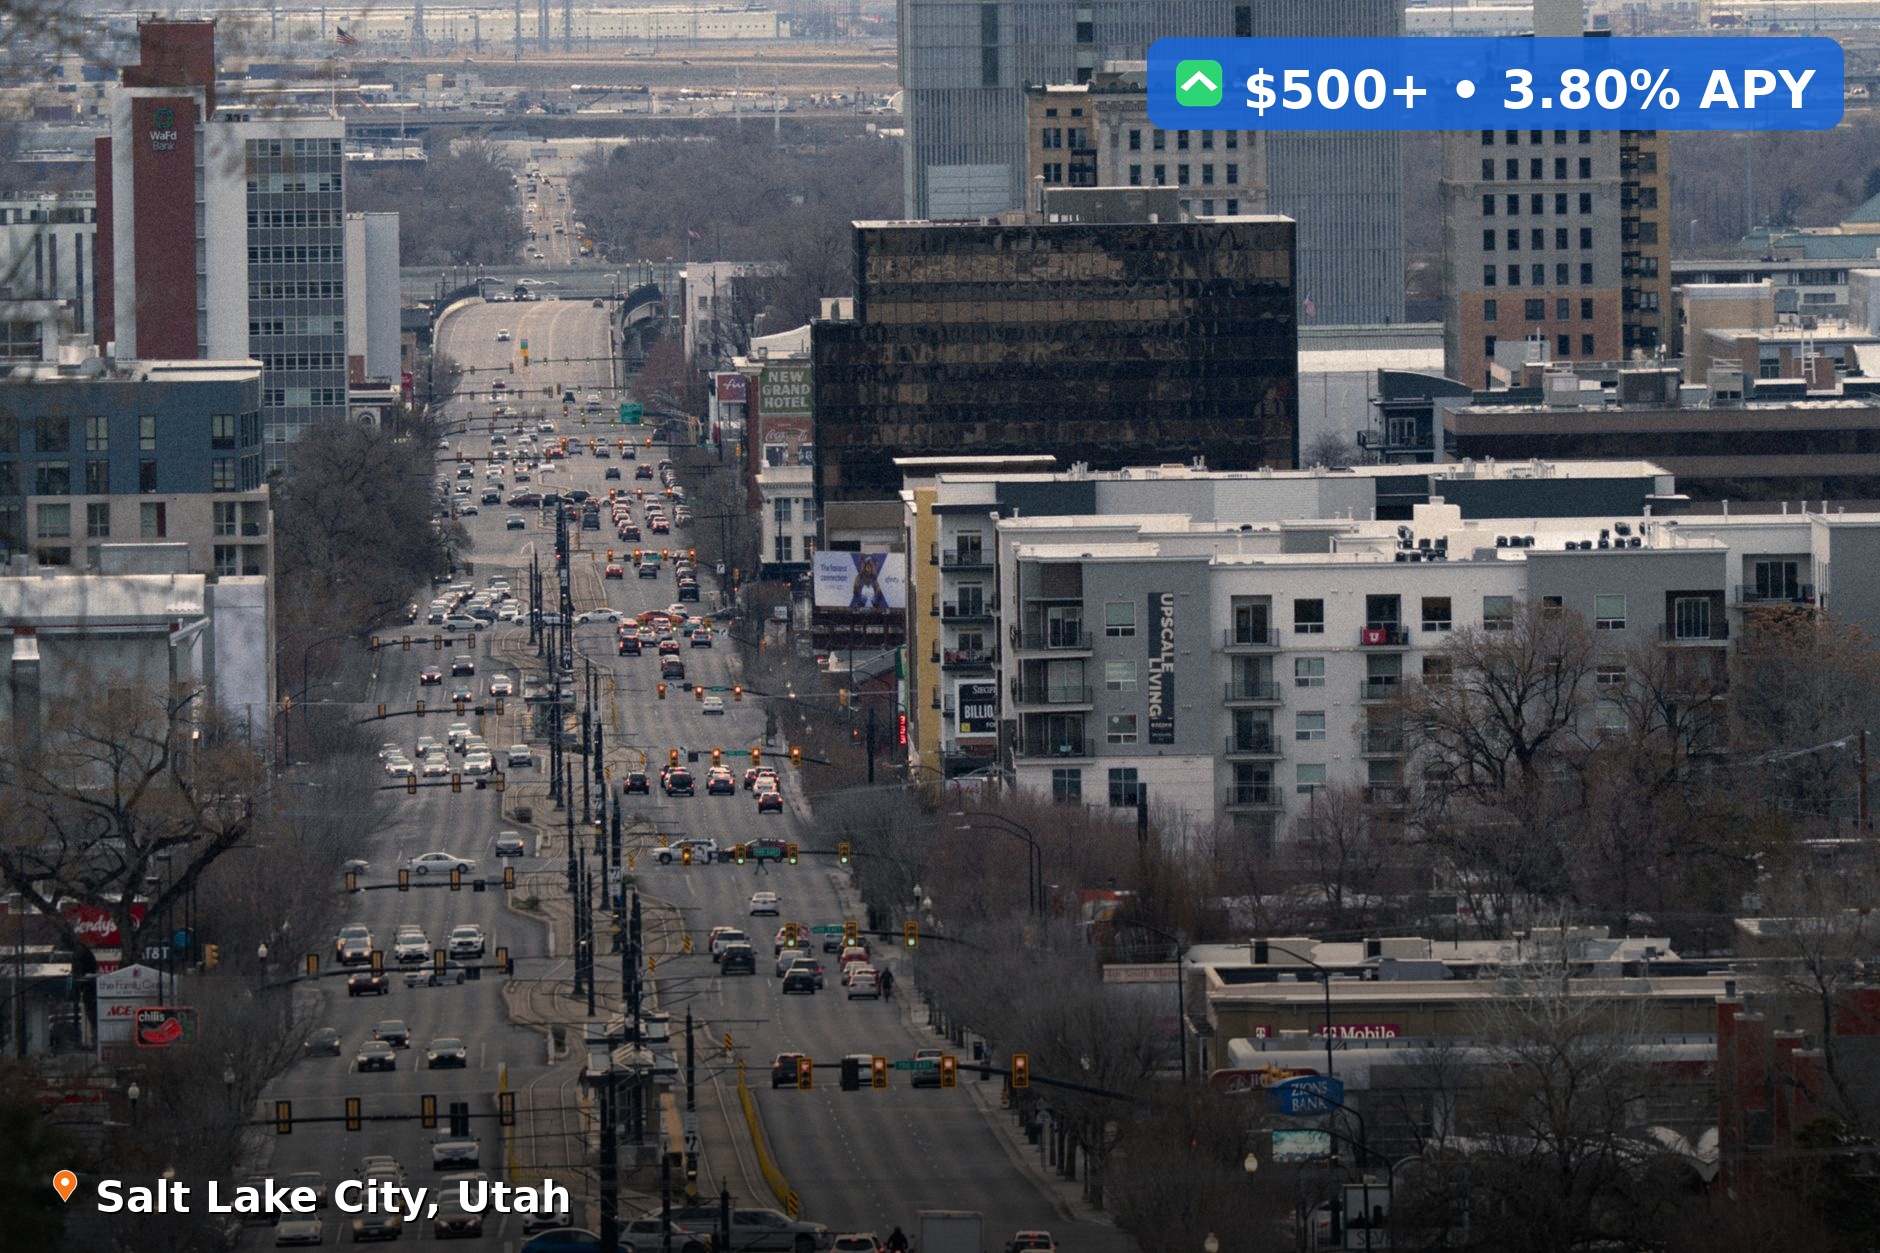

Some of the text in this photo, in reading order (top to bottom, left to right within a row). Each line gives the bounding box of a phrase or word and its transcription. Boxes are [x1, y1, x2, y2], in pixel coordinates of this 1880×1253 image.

[149, 130, 178, 140] WaFd
[768, 371, 805, 383] NEW
[761, 384, 811, 396] GRAND
[765, 397, 809, 409] HOTEL
[1161, 593, 1174, 673] UPSCALE
[1148, 657, 1163, 718] LIVING
[964, 704, 994, 719] BILLIO
[106, 1005, 133, 1016] ACE
[1339, 1026, 1396, 1039] Mobile
[1290, 1082, 1328, 1097] ZIONS
[1291, 1098, 1328, 1112] BANK
